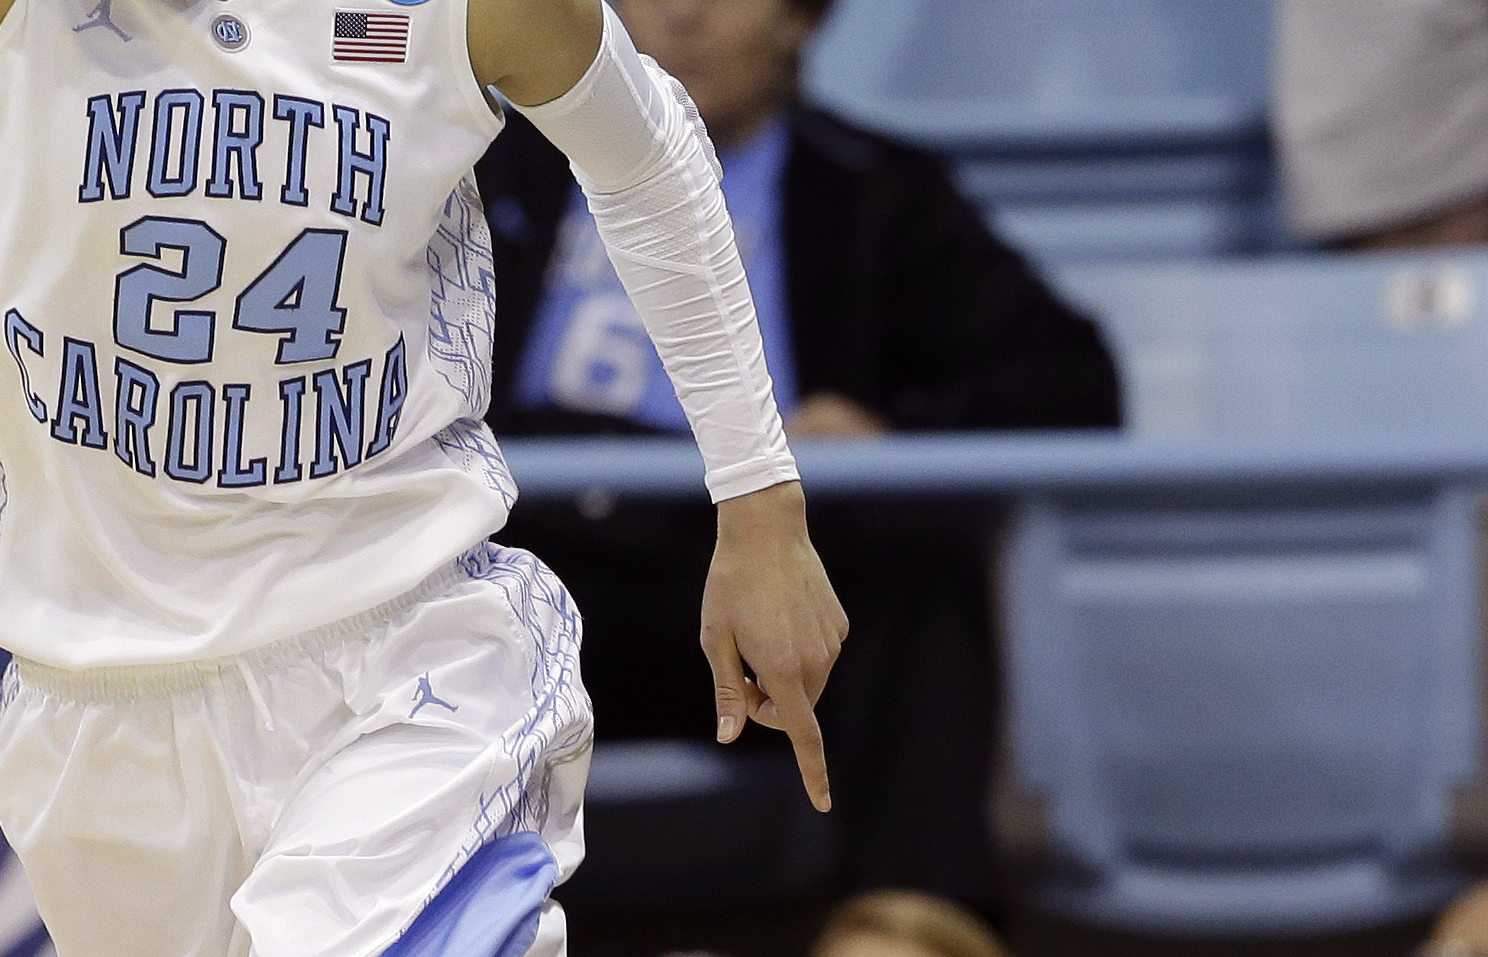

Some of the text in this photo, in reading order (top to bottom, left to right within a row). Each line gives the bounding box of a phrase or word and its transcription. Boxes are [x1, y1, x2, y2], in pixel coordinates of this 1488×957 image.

[78, 88, 391, 226] NORTH
[112, 215, 349, 365] 24
[4, 306, 409, 489] CAROLINA
